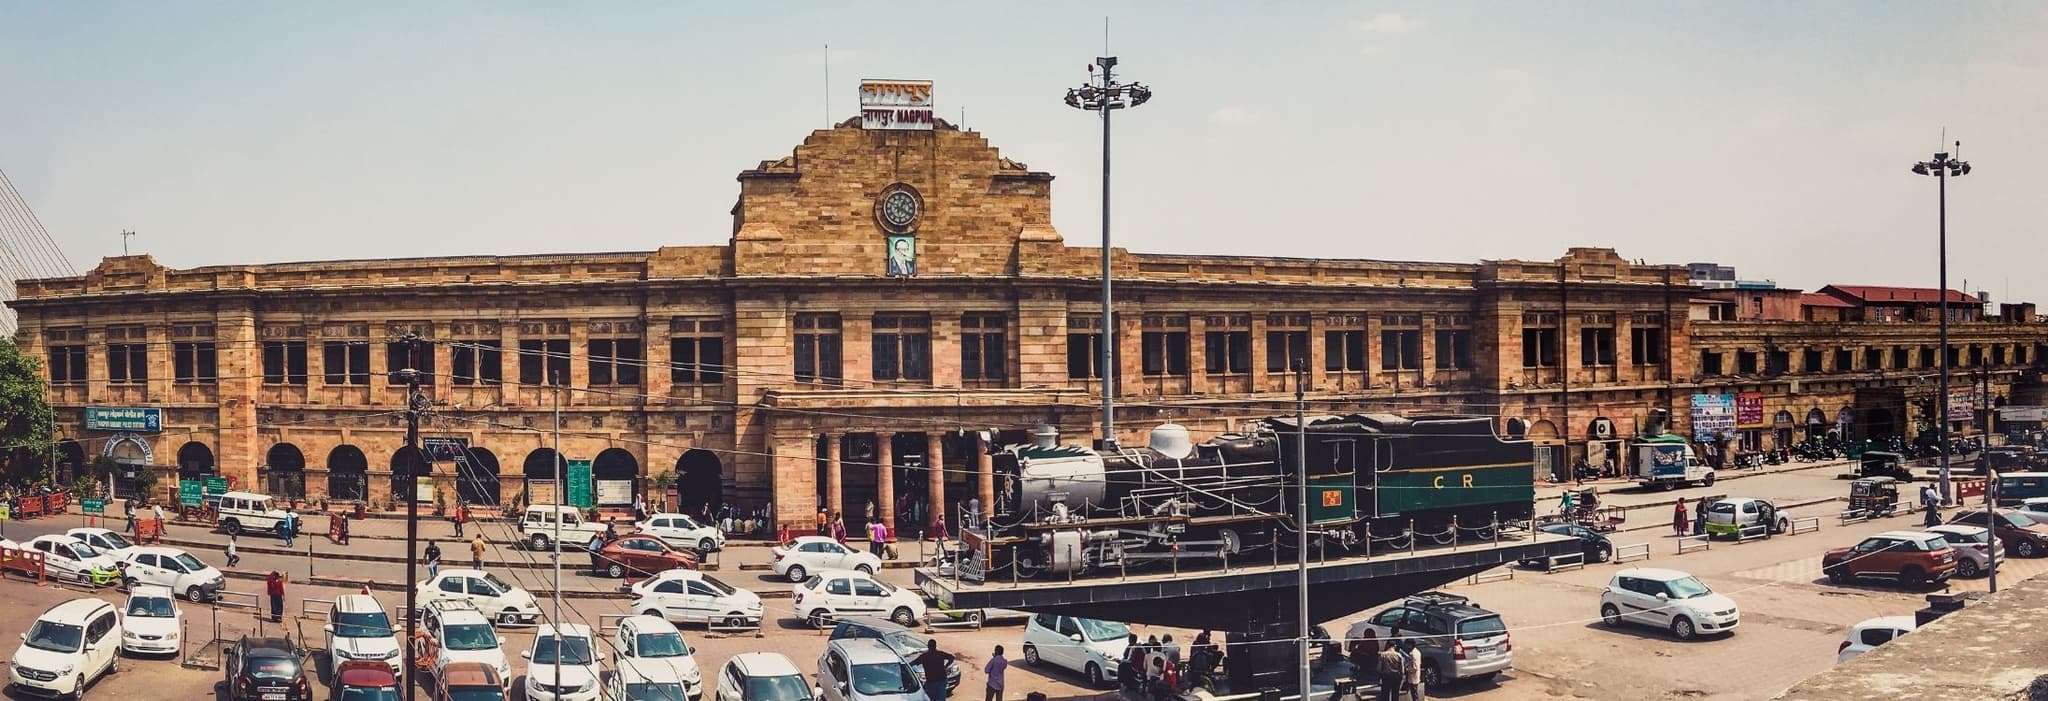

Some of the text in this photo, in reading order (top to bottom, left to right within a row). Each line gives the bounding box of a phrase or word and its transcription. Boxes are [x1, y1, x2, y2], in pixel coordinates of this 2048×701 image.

[863, 84, 932, 101] नागपूर
[863, 109, 933, 125] नागपुर NAGPUR
[1434, 474, 1473, 489] C R
